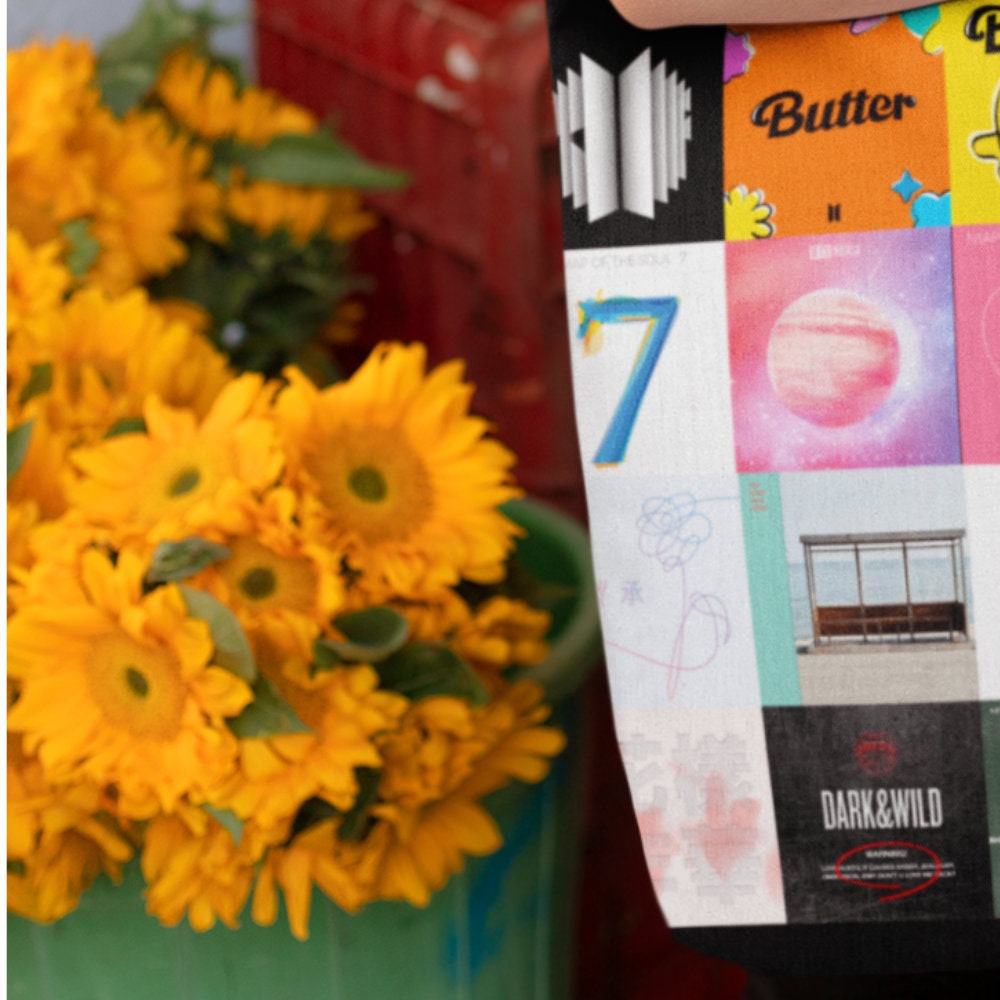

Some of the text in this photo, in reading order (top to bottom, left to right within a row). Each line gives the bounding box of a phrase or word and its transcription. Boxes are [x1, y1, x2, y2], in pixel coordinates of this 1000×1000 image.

[751, 89, 916, 139] Butter
[576, 292, 681, 468] 7
[820, 787, 943, 830] DARK&WILD
